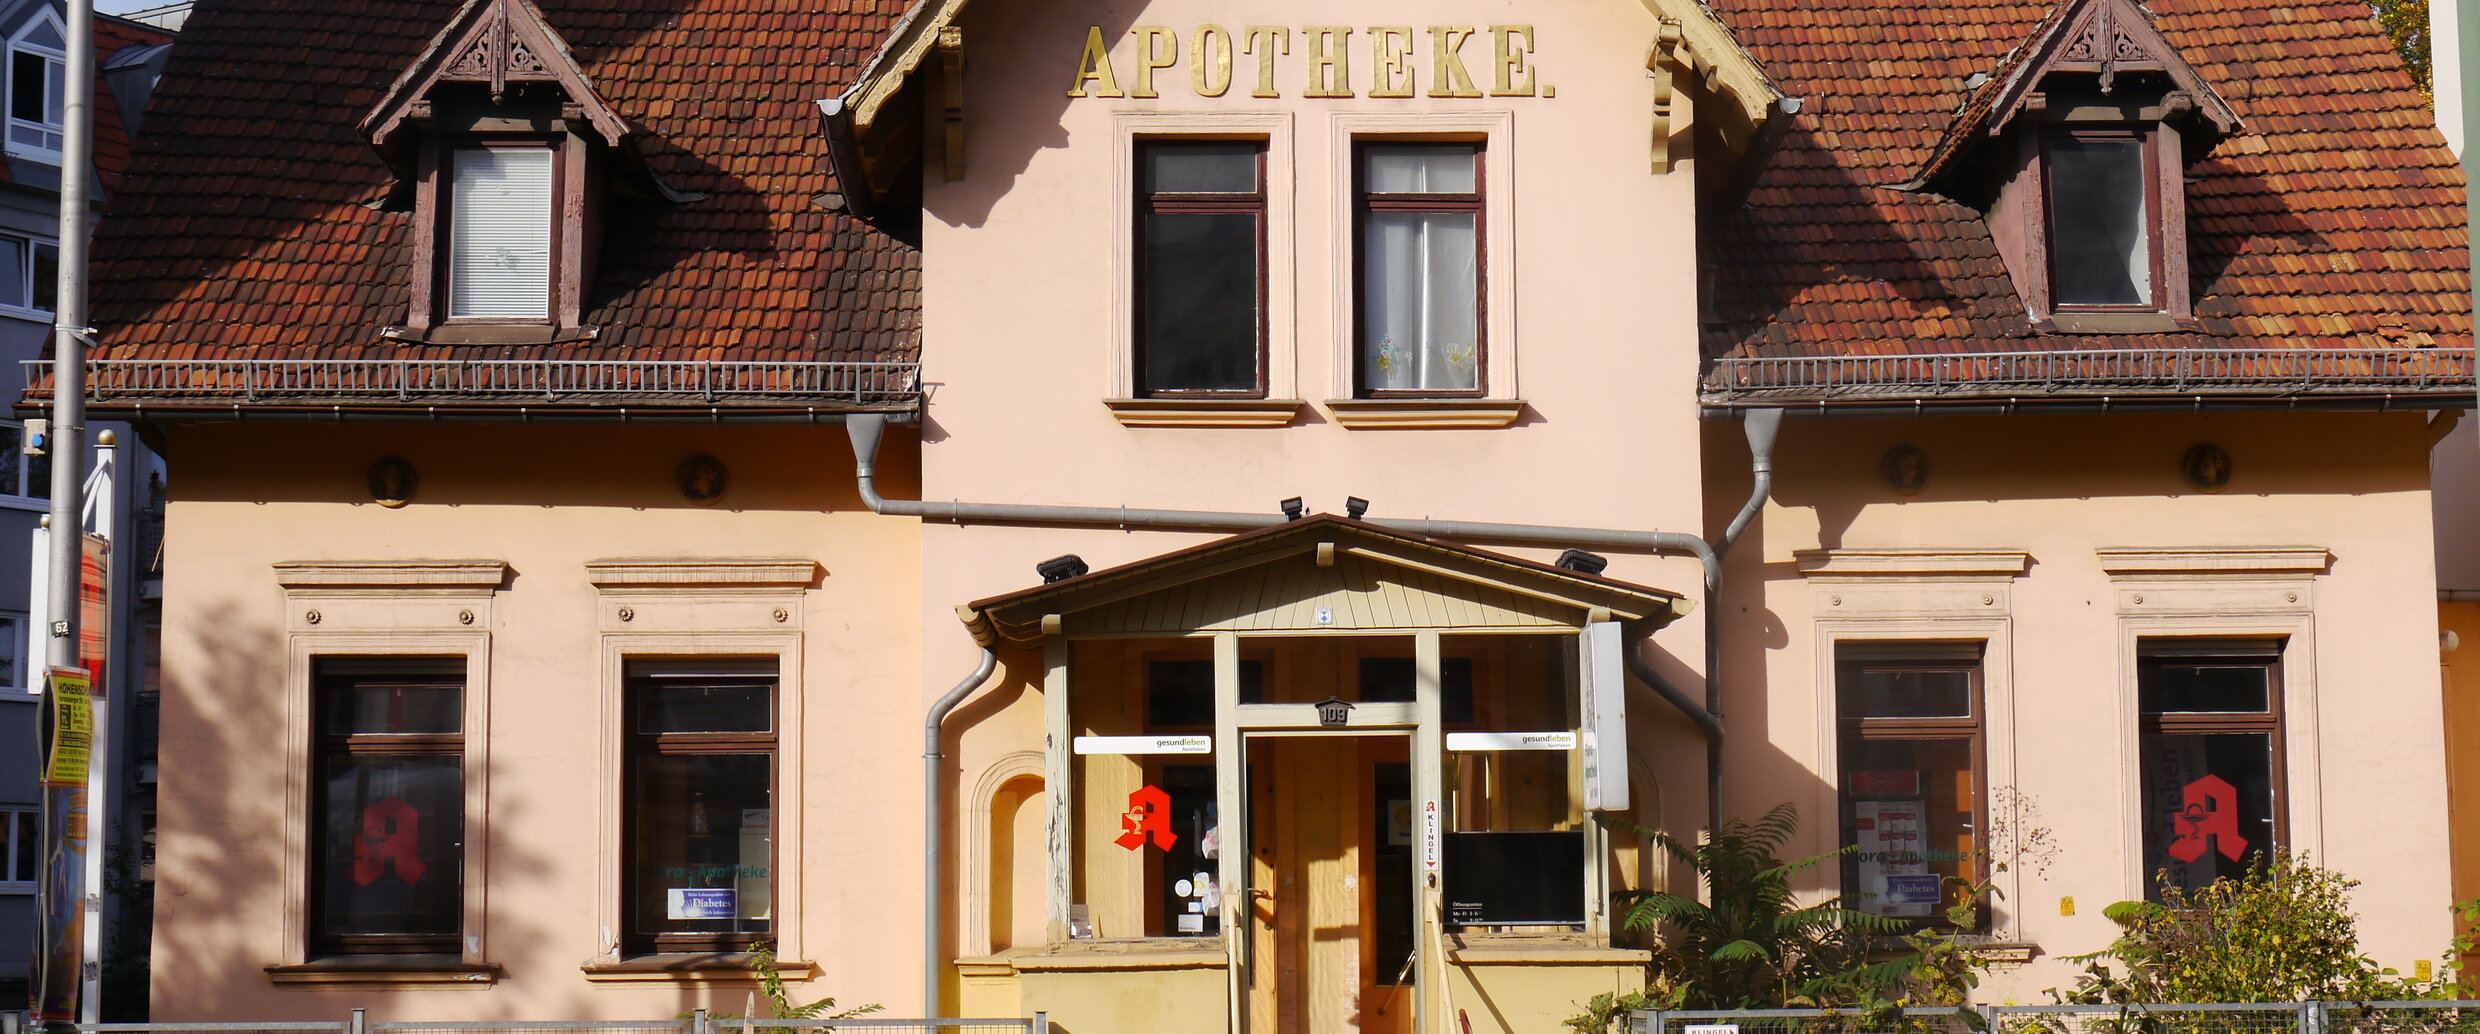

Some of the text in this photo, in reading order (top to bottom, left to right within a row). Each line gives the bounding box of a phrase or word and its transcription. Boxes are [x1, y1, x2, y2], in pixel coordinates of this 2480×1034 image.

[1067, 24, 1557, 99] APOTHEKE.
[55, 621, 69, 633] 62
[1321, 707, 1347, 722] 109
[1156, 738, 1206, 748] gesundleben
[1522, 735, 1571, 744] gesundleben
[1897, 883, 1936, 893] Diabetes
[692, 897, 732, 908] Diabetes
